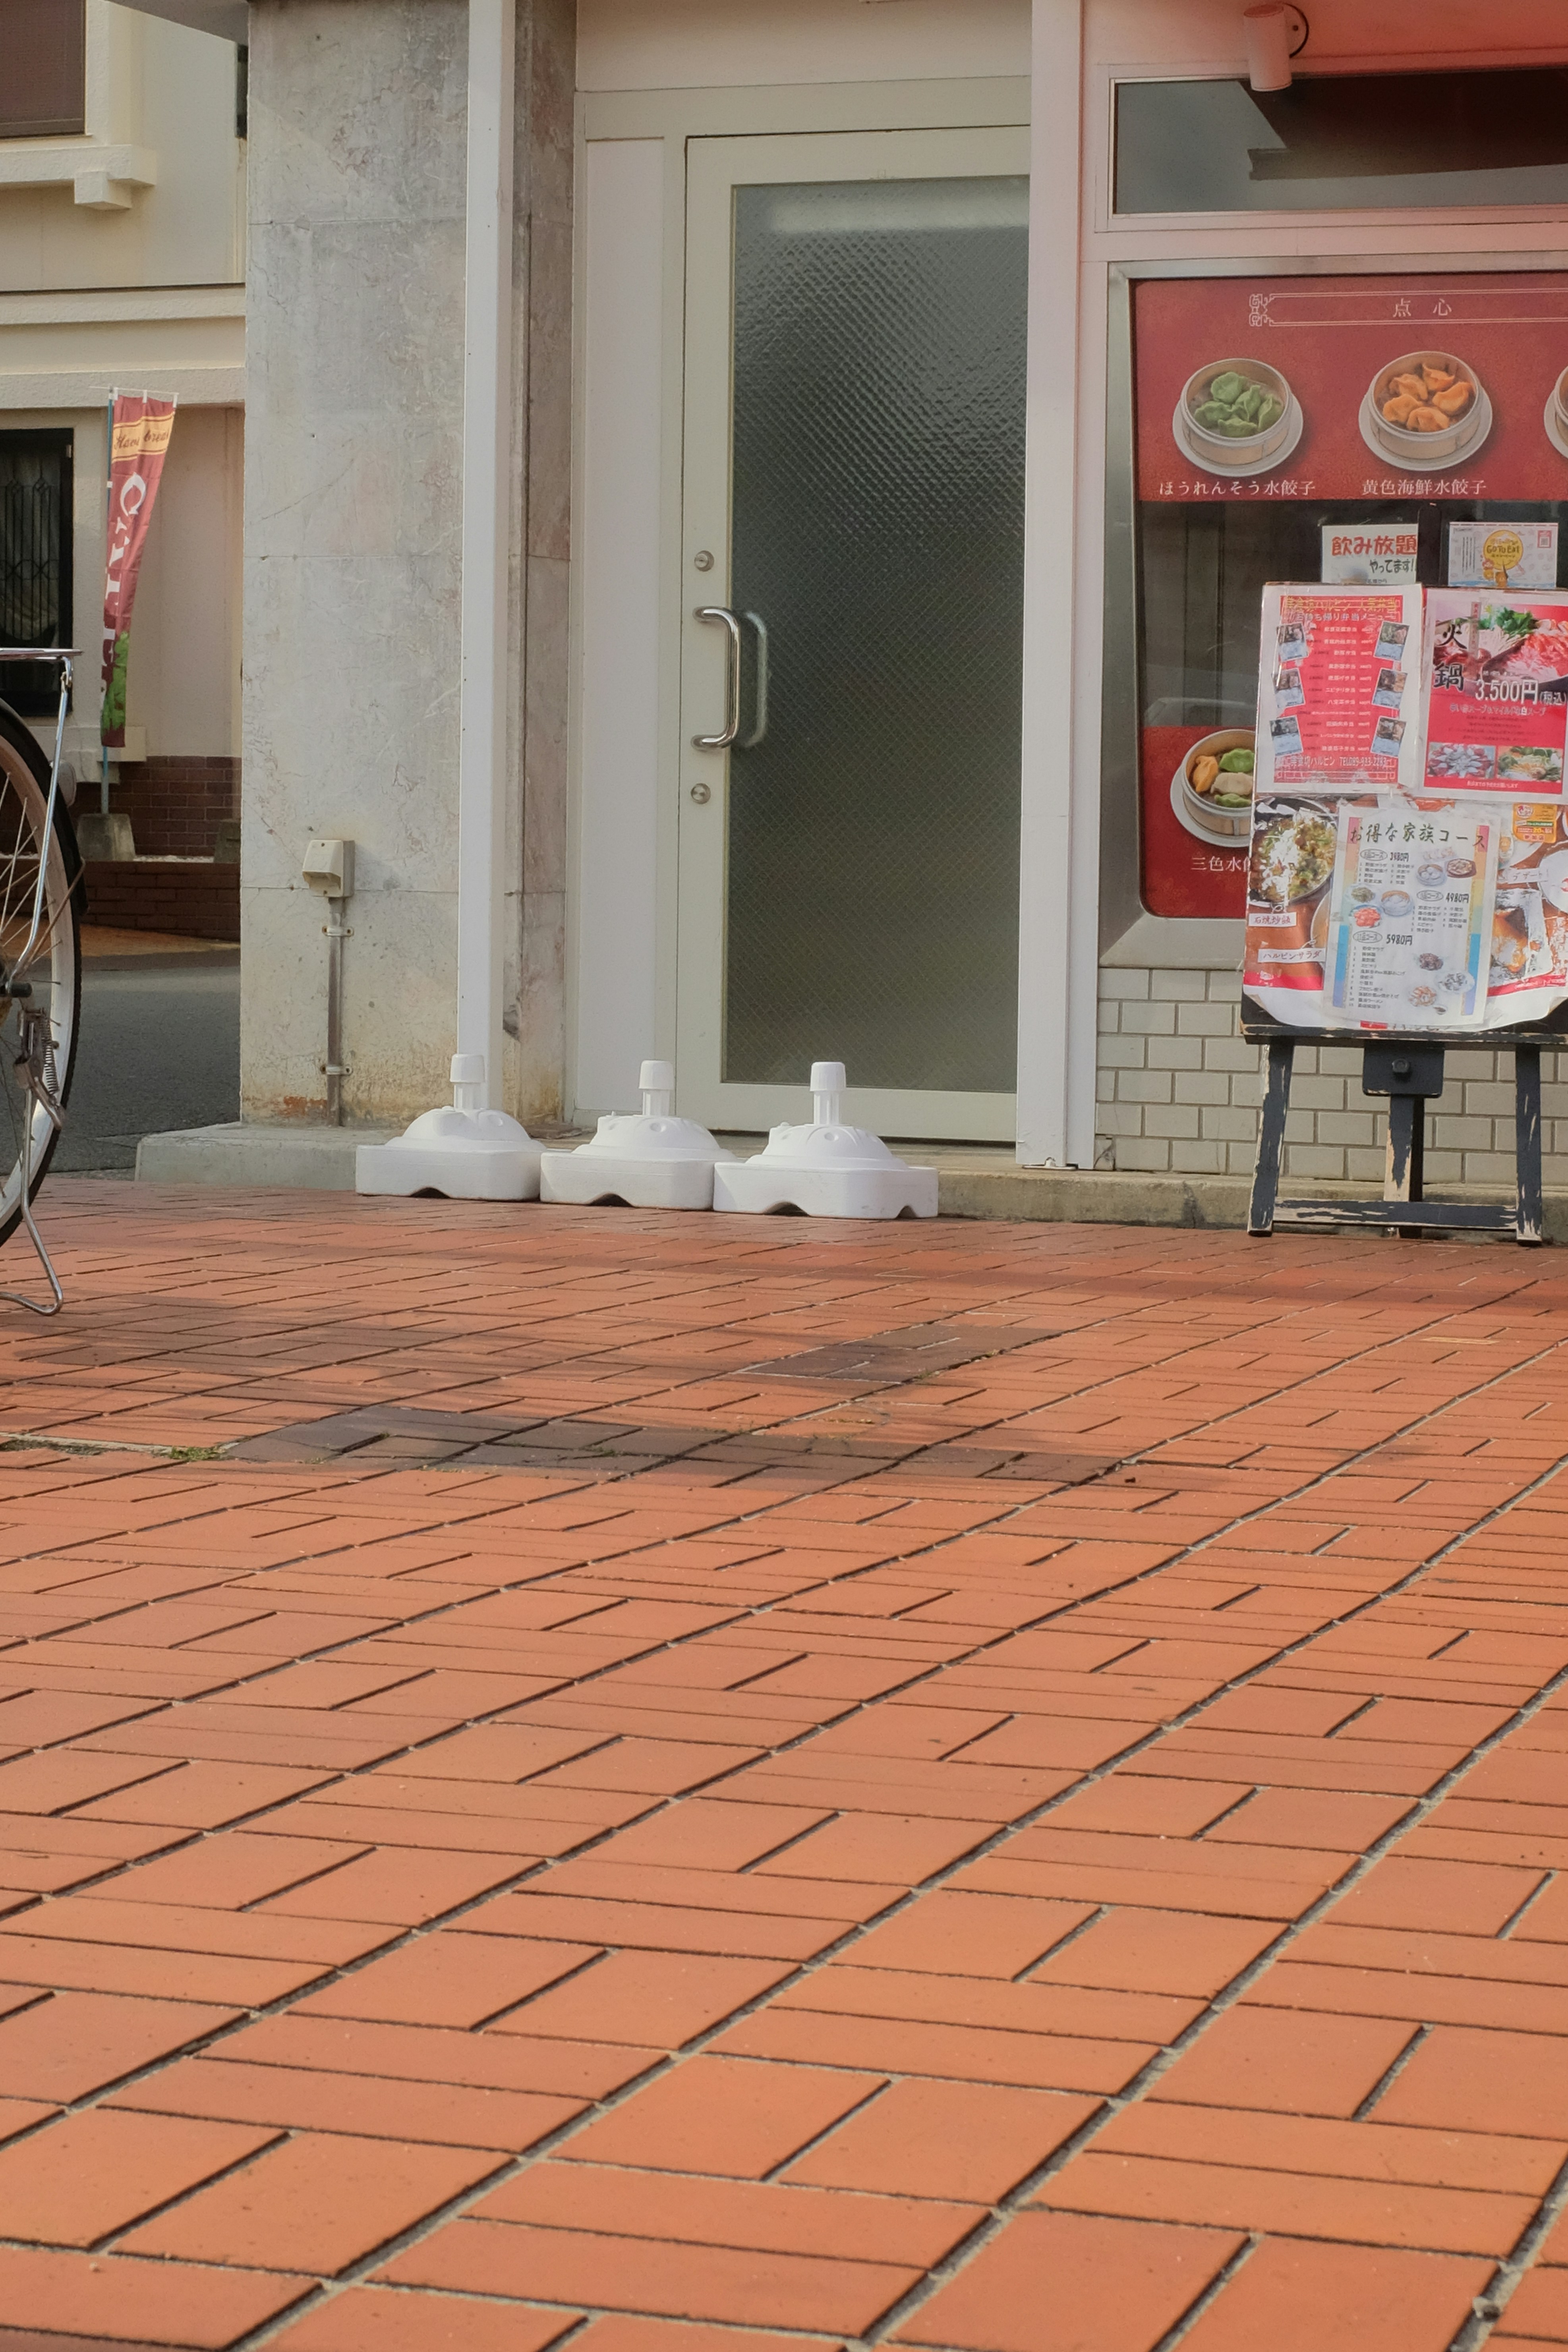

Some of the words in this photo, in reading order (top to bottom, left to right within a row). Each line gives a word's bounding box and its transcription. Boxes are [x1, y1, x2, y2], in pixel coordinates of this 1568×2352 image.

[1393, 298, 1452, 318] 点心
[1159, 479, 1315, 497] ほうれんそう水餃子
[1361, 479, 1487, 496] 黄色海鮮水餃子
[1332, 534, 1417, 557] 飲み放題
[1350, 822, 1485, 848] お得な家族コース
[1446, 893, 1469, 903] 4980円
[1386, 934, 1413, 946] 5980円
